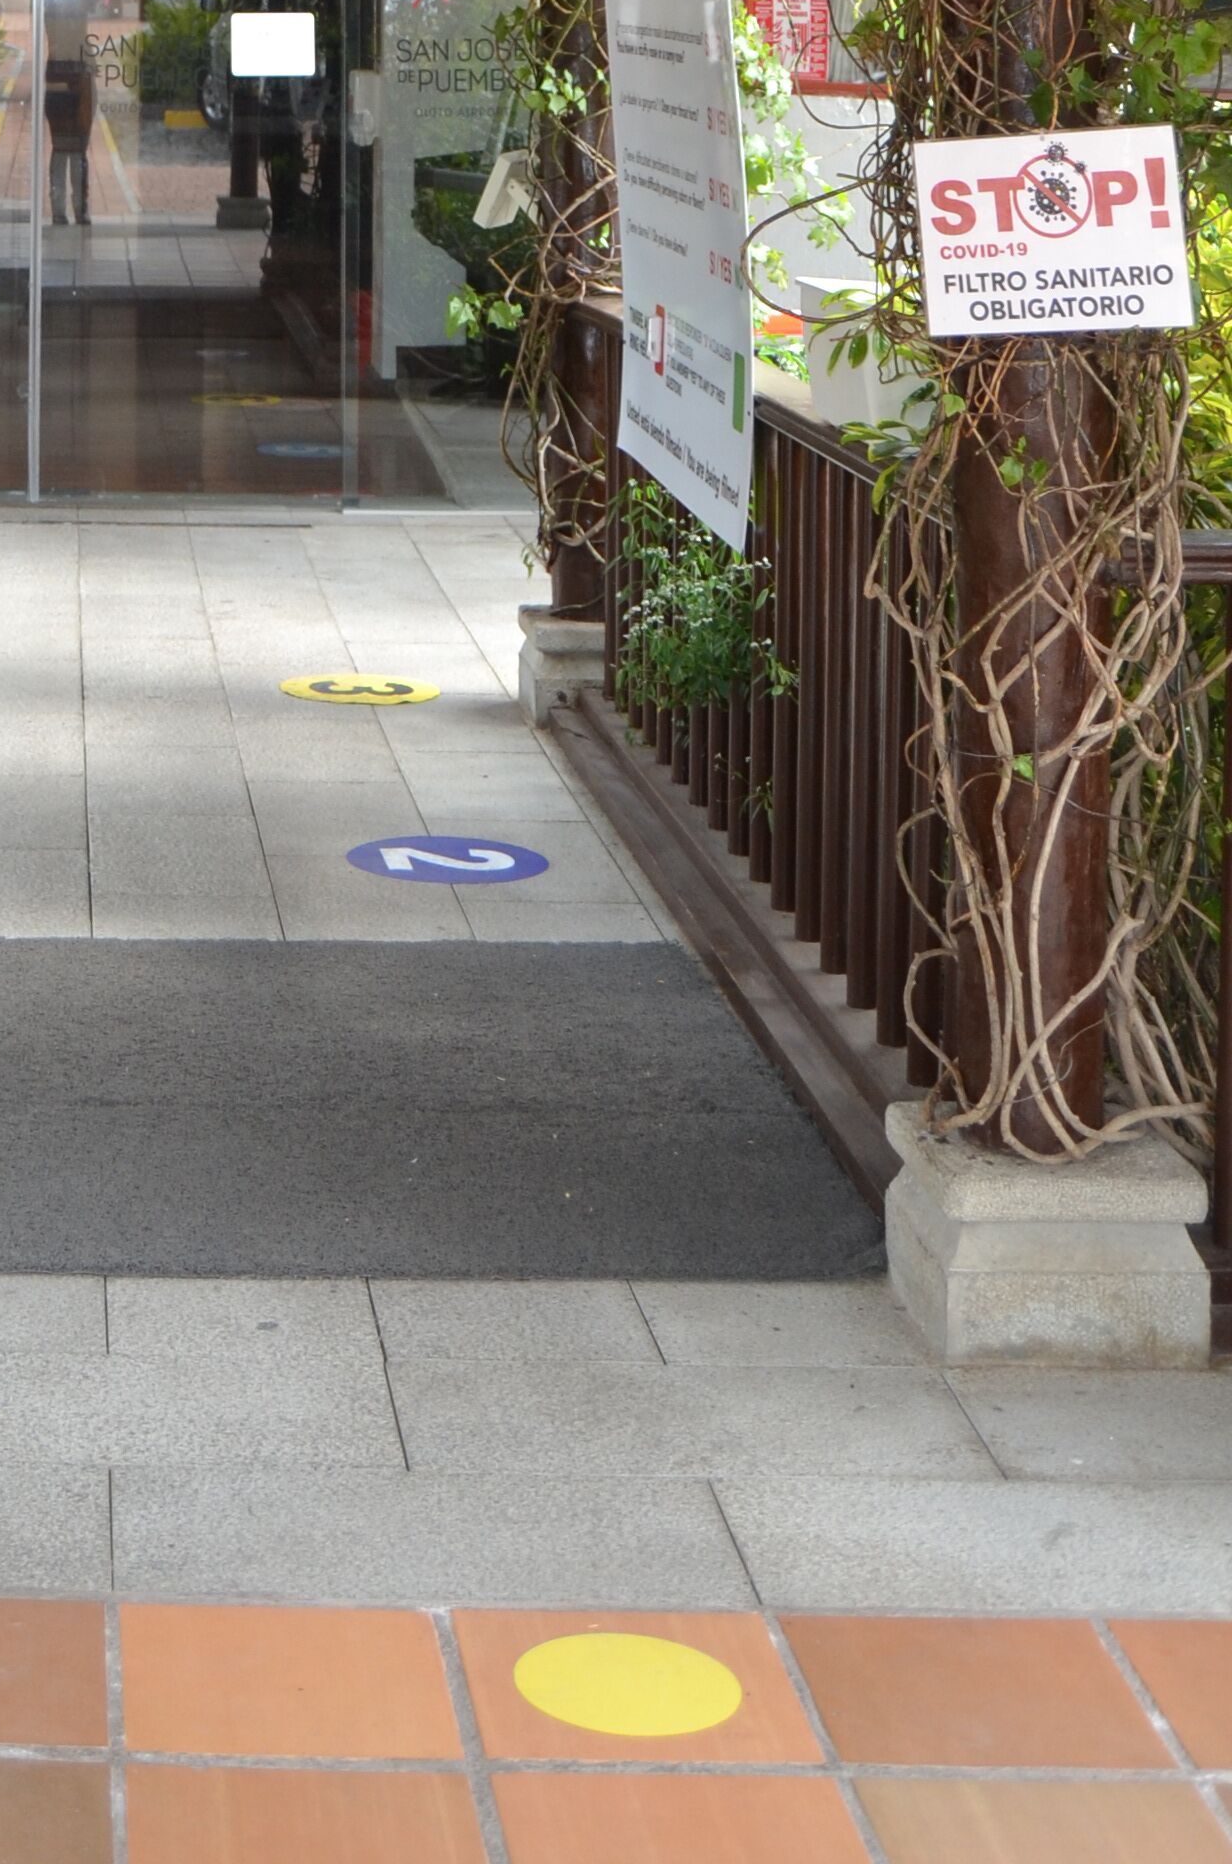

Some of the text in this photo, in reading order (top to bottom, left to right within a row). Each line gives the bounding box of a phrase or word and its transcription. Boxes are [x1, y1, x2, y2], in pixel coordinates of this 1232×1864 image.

[84, 33, 137, 58] SAN
[396, 38, 449, 63] SAN
[939, 241, 1028, 260] COVID-19
[943, 263, 1174, 294] FILTRO SANITARIO
[969, 293, 1145, 322] OBLIGATORIO
[308, 678, 415, 697] 3
[378, 845, 516, 875] 2
